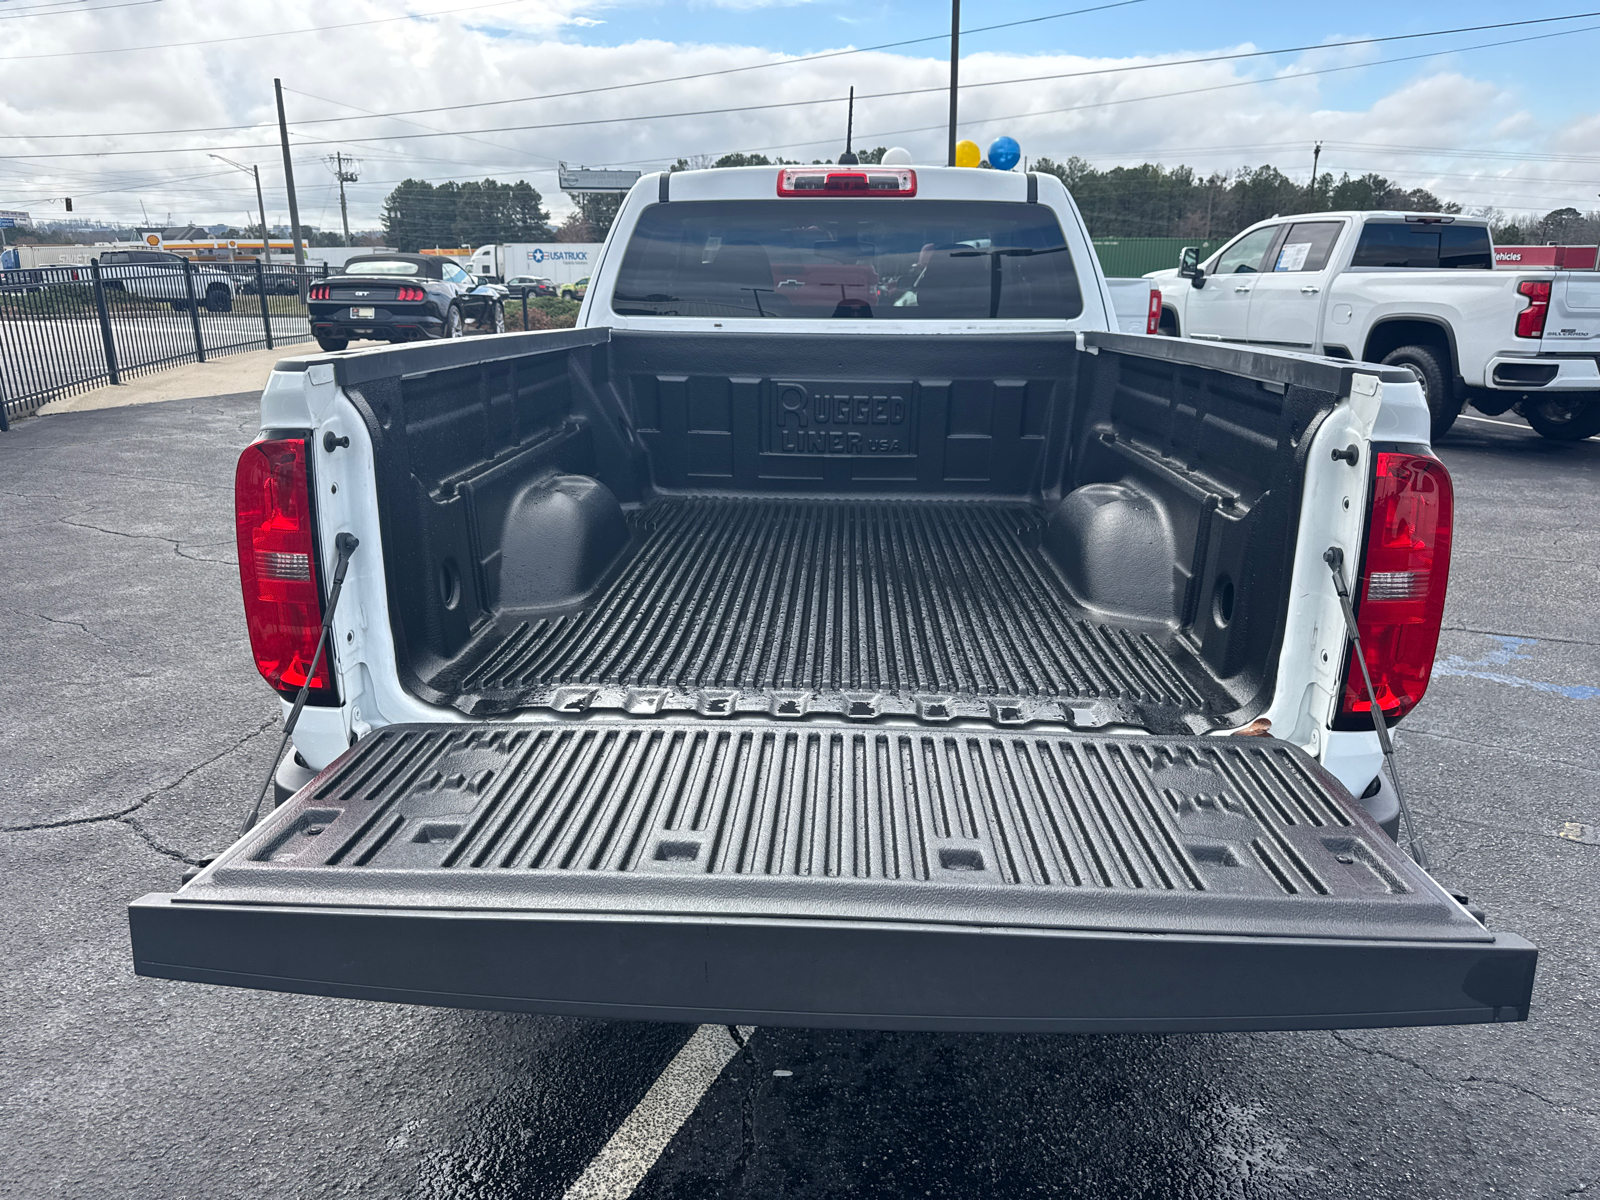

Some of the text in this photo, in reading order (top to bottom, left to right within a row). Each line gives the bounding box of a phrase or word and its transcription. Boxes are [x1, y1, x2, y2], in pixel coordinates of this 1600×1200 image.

[776, 382, 906, 428] RUGGED
[781, 429, 900, 454] LINER USA
